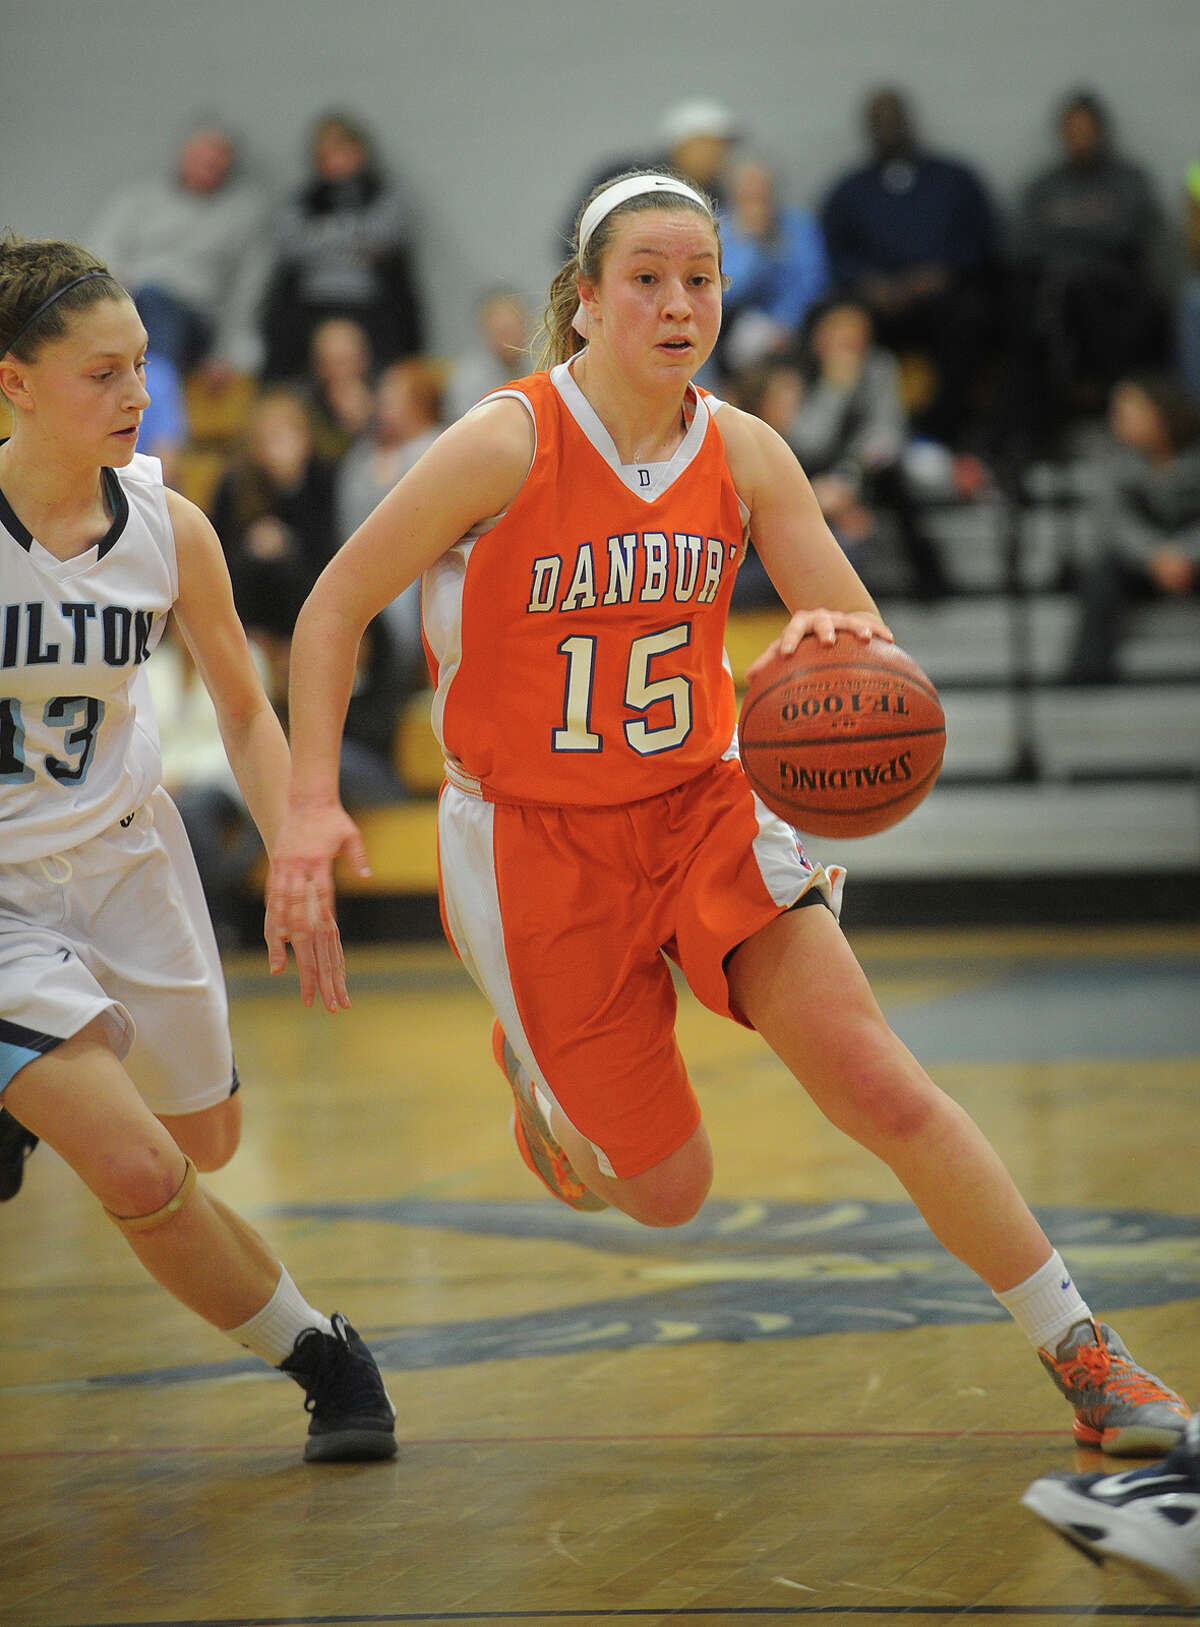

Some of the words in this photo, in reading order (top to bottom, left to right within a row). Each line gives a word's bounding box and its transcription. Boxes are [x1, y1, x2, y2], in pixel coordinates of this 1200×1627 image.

[637, 469, 651, 487] D
[0, 601, 154, 669] ILTON
[551, 621, 693, 757] 15
[778, 750, 912, 792] SPALDING
